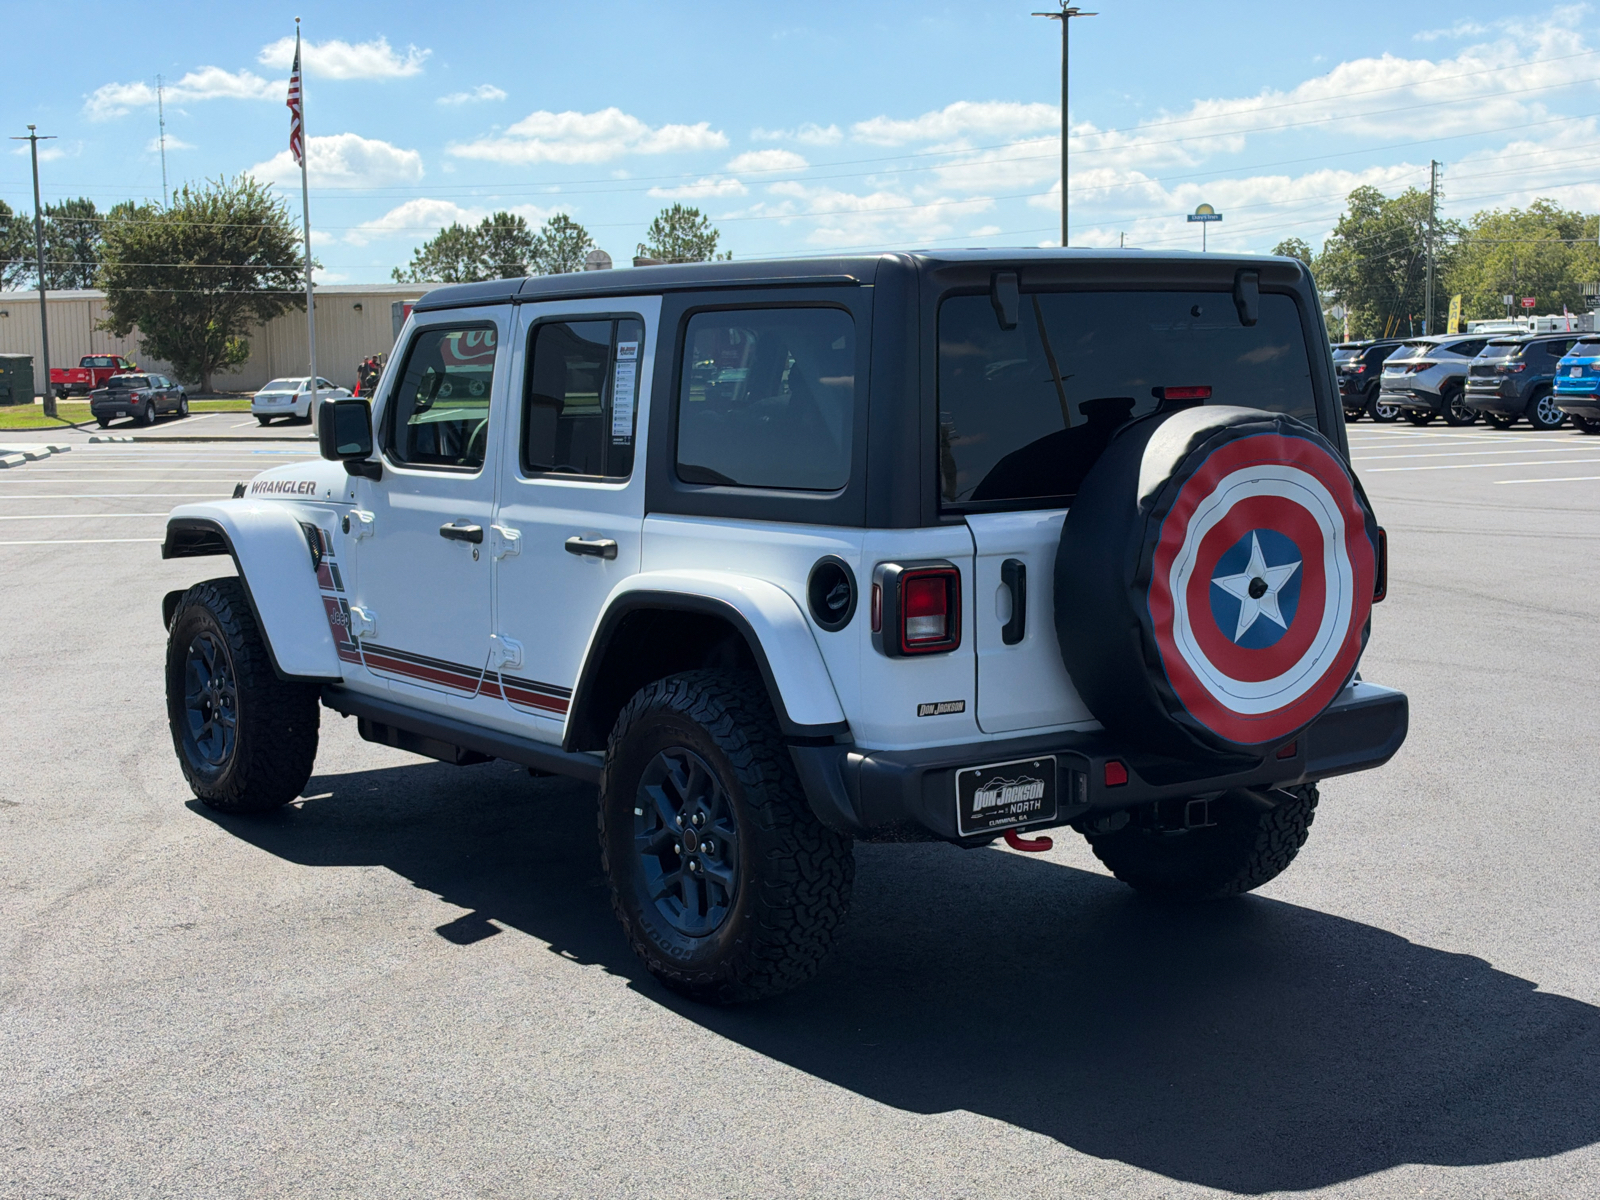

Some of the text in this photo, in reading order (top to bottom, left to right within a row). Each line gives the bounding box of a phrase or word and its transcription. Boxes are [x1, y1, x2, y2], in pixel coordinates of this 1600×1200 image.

[251, 481, 317, 495] WRANGLER
[330, 607, 349, 628] Jeep
[1010, 800, 1041, 814] NORTH
